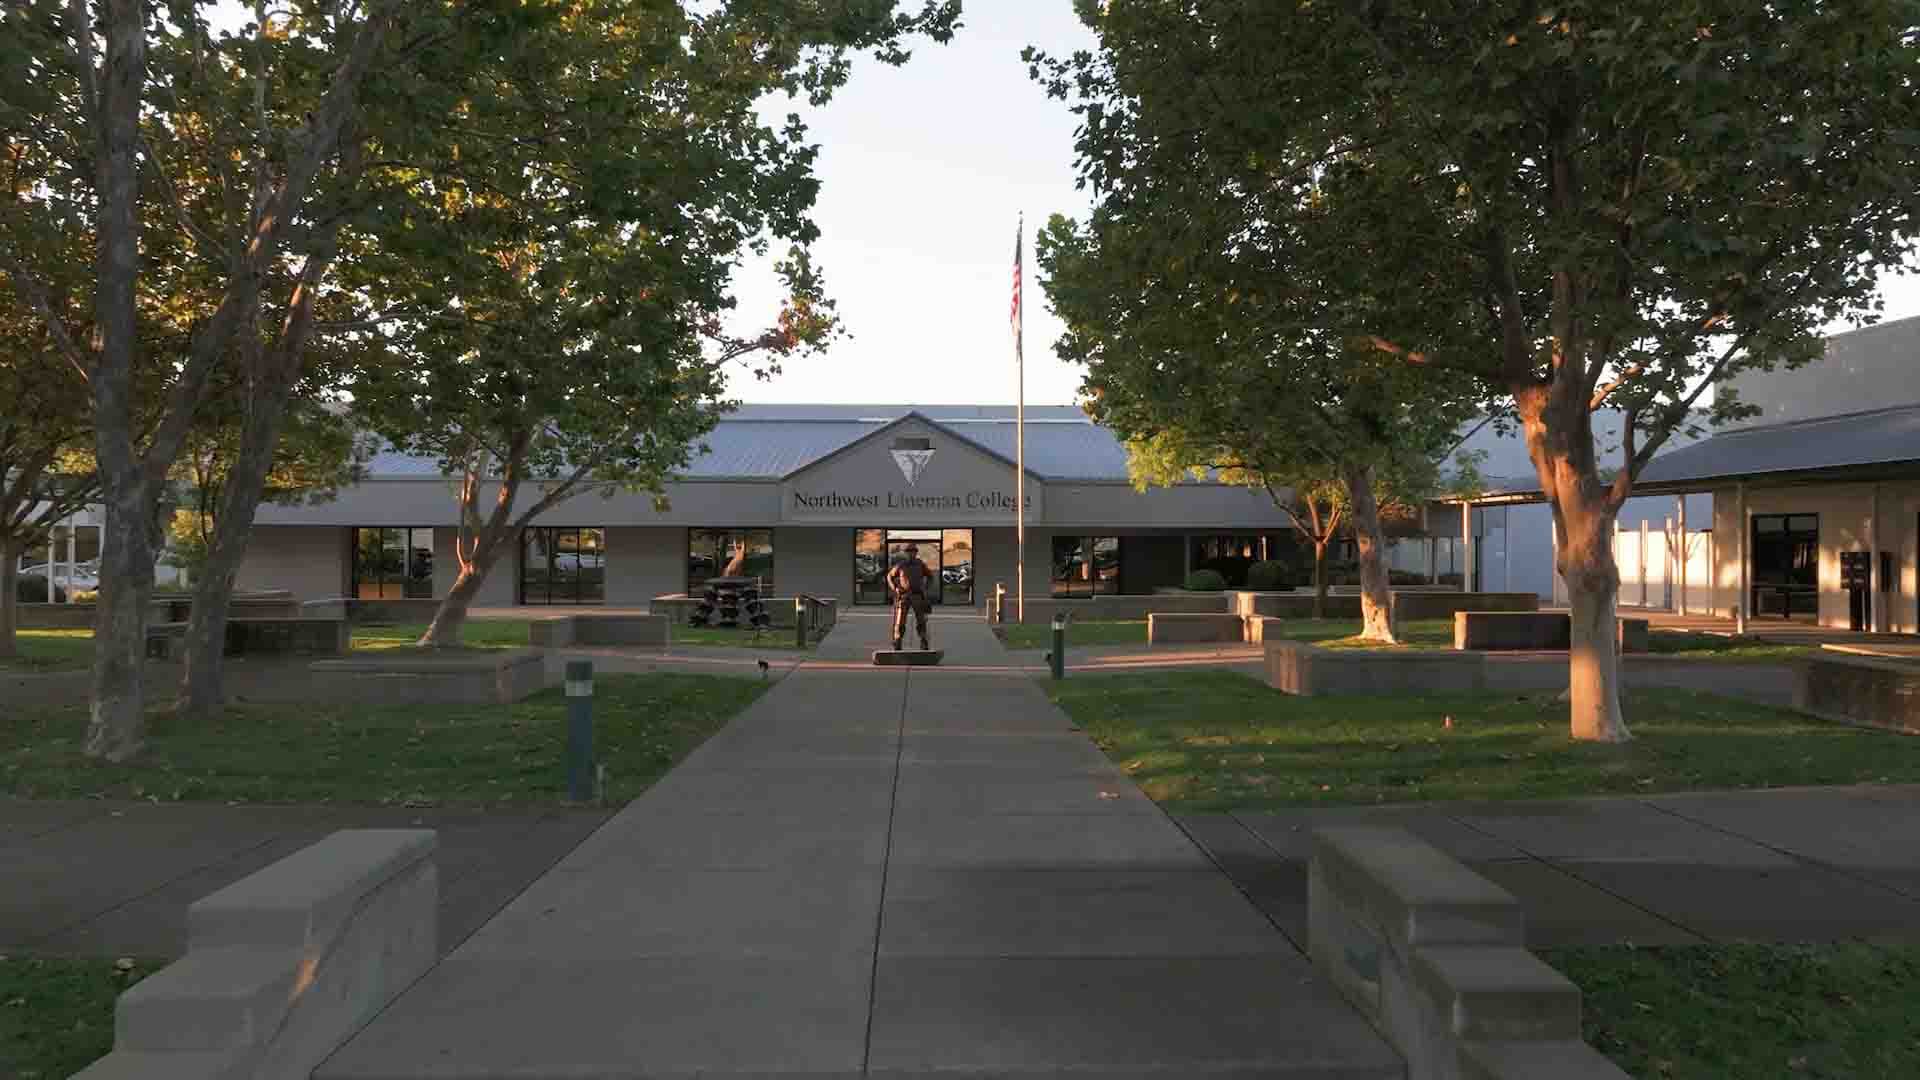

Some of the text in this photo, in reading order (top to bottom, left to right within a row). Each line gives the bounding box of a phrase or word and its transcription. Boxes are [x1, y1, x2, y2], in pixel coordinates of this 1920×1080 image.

[794, 490, 1032, 511] Northwest Lineman College
